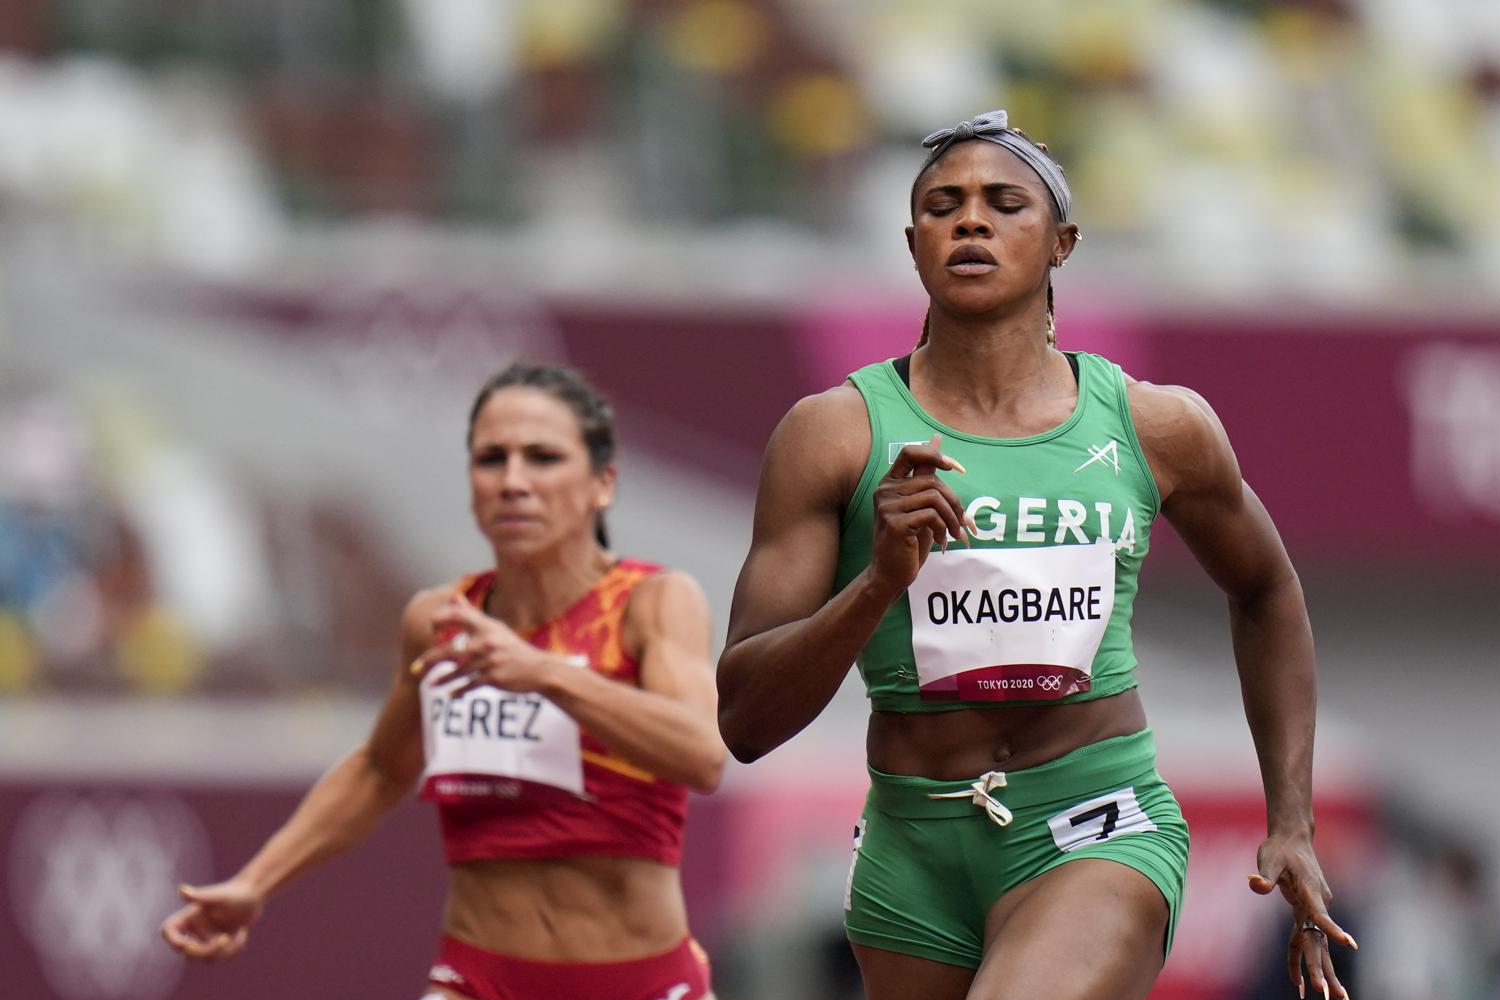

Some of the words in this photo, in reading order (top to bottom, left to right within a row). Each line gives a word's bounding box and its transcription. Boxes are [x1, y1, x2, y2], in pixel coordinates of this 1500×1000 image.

[943, 496, 1136, 554] GERIA
[927, 586, 1101, 626] OKAGBARE
[977, 679, 1008, 690] TOKYO
[1010, 678, 1034, 689] 2020
[1069, 801, 1119, 841] 7
